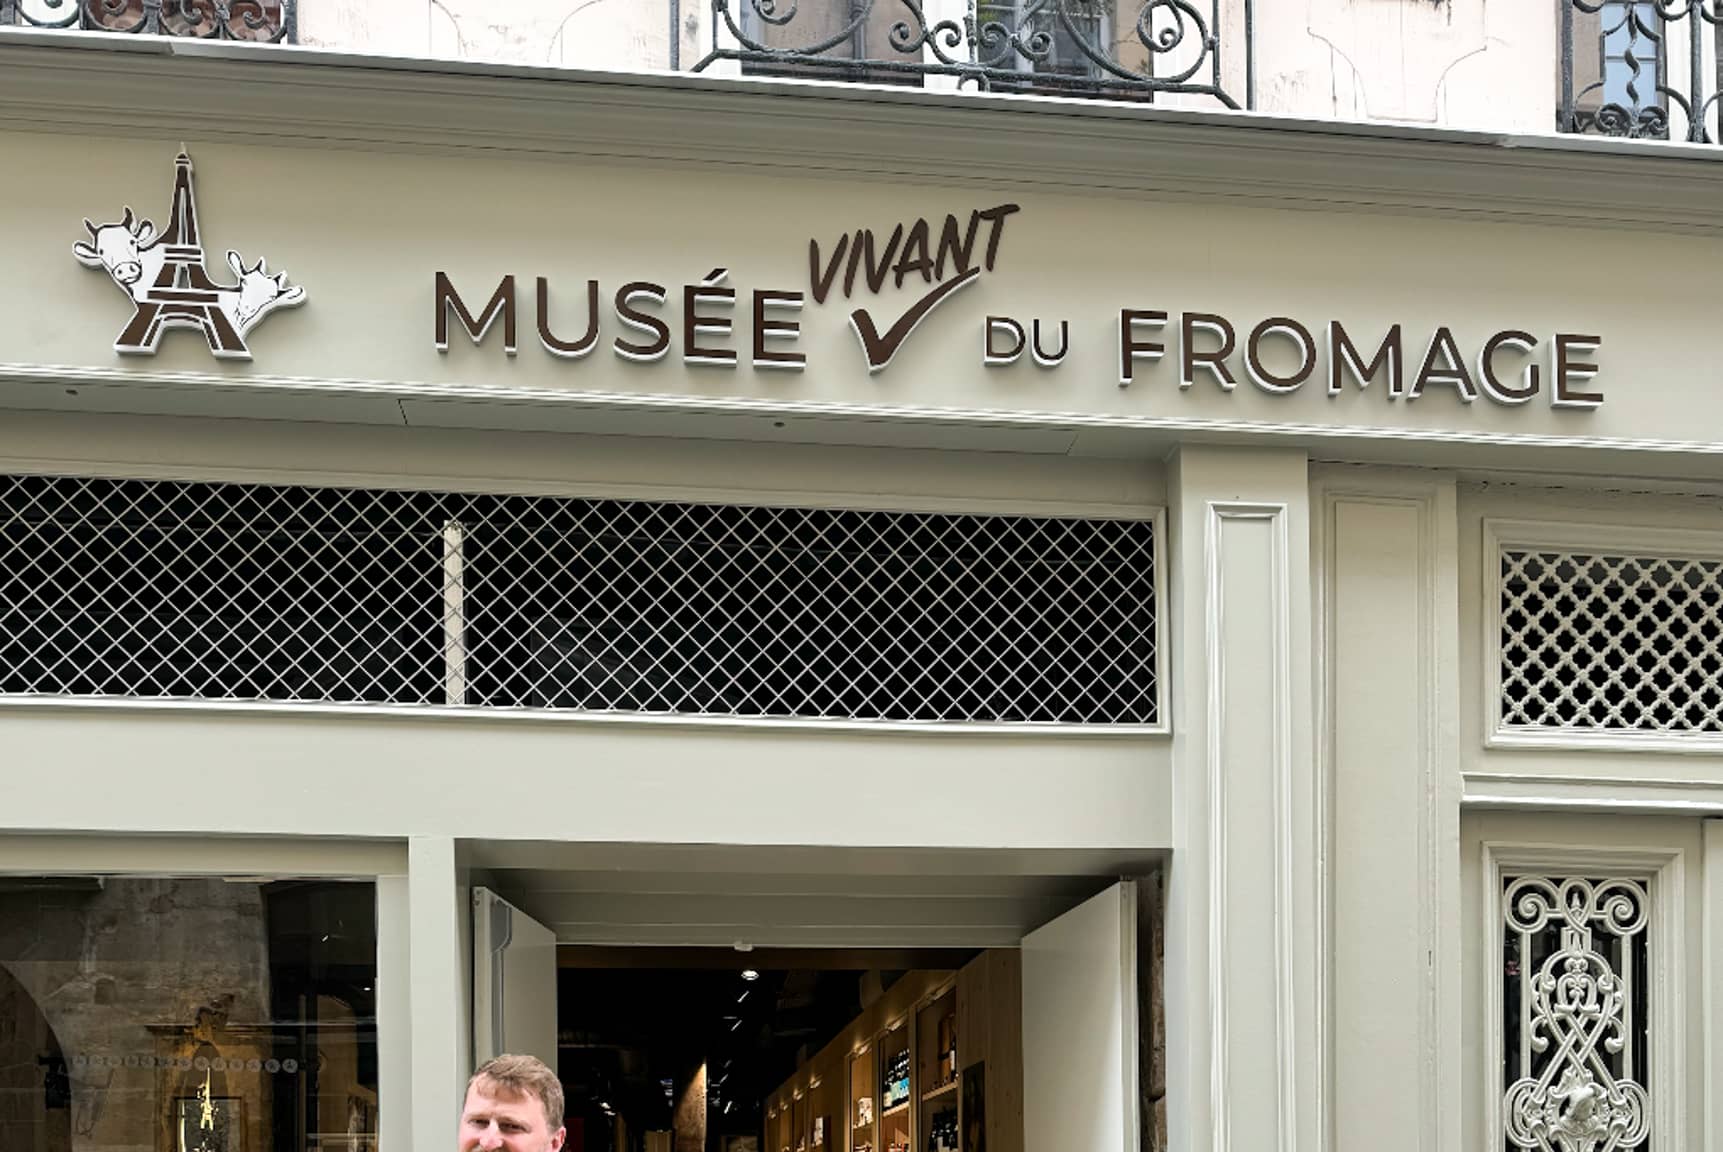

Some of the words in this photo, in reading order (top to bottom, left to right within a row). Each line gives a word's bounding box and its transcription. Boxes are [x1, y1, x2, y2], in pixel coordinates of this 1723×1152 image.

[810, 203, 1021, 304] VIVANT
[435, 267, 806, 370] MUSÉE
[984, 314, 1069, 367] DU
[1118, 307, 1605, 411] FROMAGE
